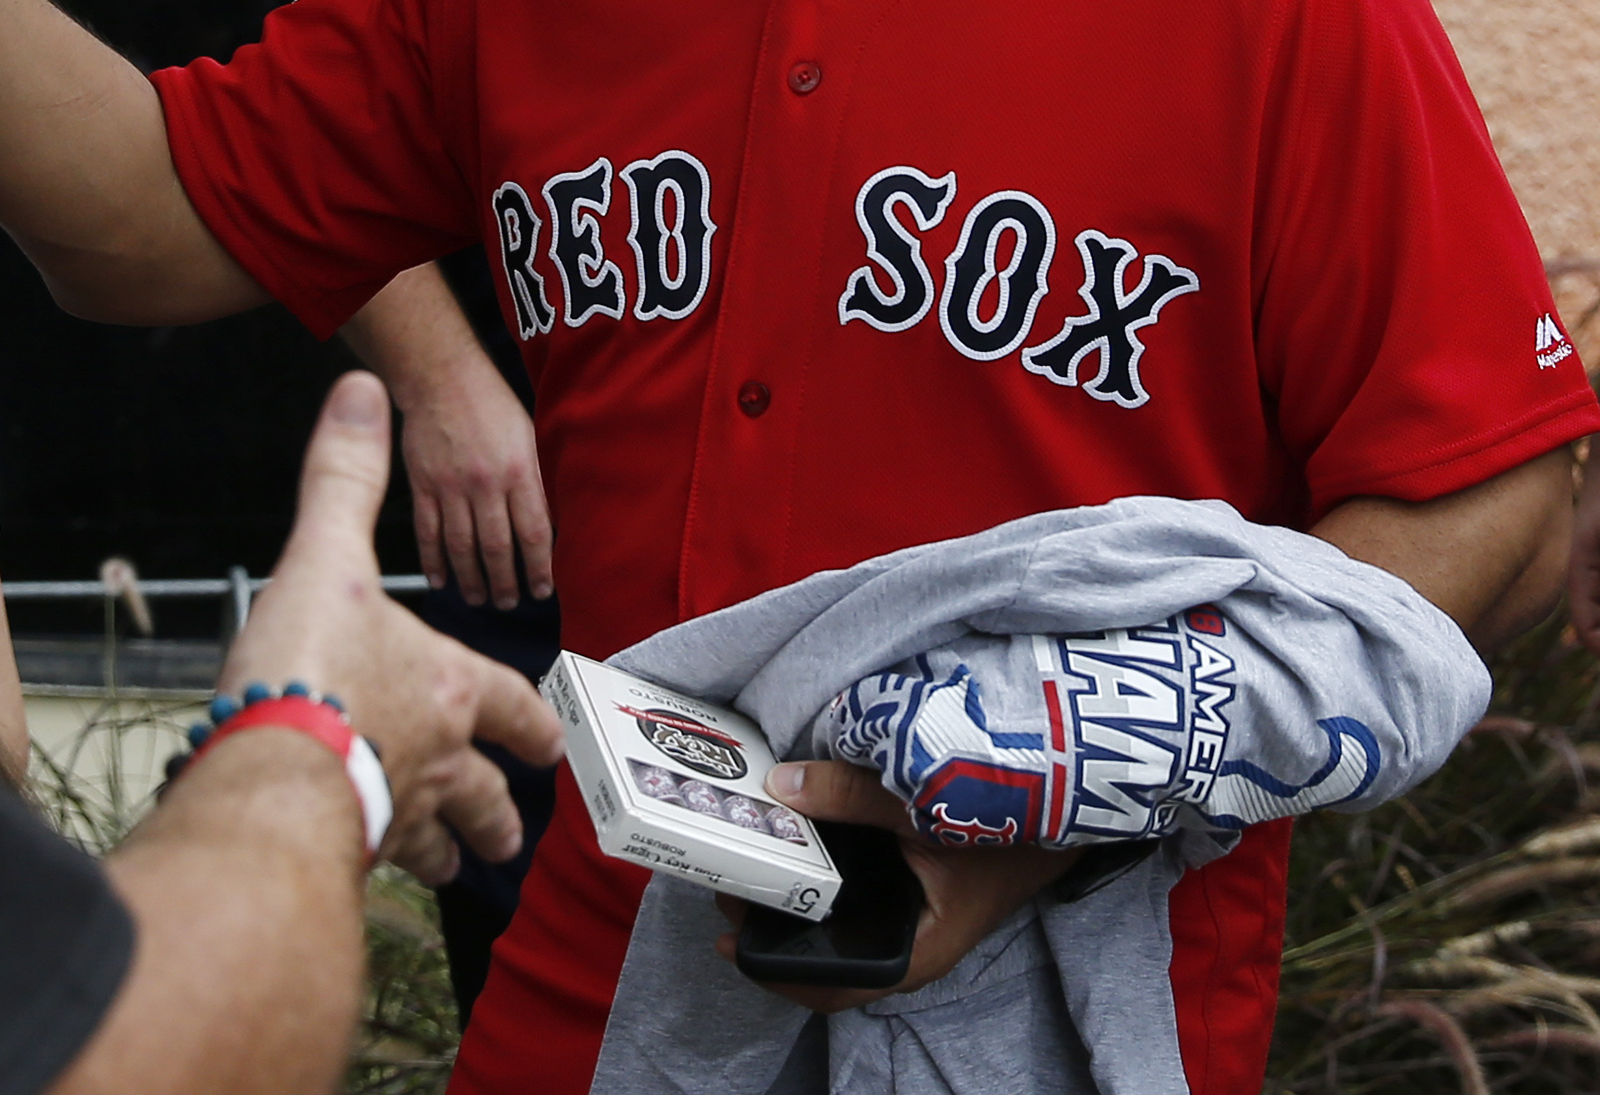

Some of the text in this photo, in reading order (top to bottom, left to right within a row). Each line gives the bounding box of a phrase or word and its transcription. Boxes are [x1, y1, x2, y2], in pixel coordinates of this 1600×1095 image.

[492, 149, 1200, 409] RED SOX
[628, 688, 718, 723] ROBUSTO
[622, 844, 661, 862] Cigar
[630, 833, 687, 857] ROBUSTO
[792, 887, 820, 914] 5
